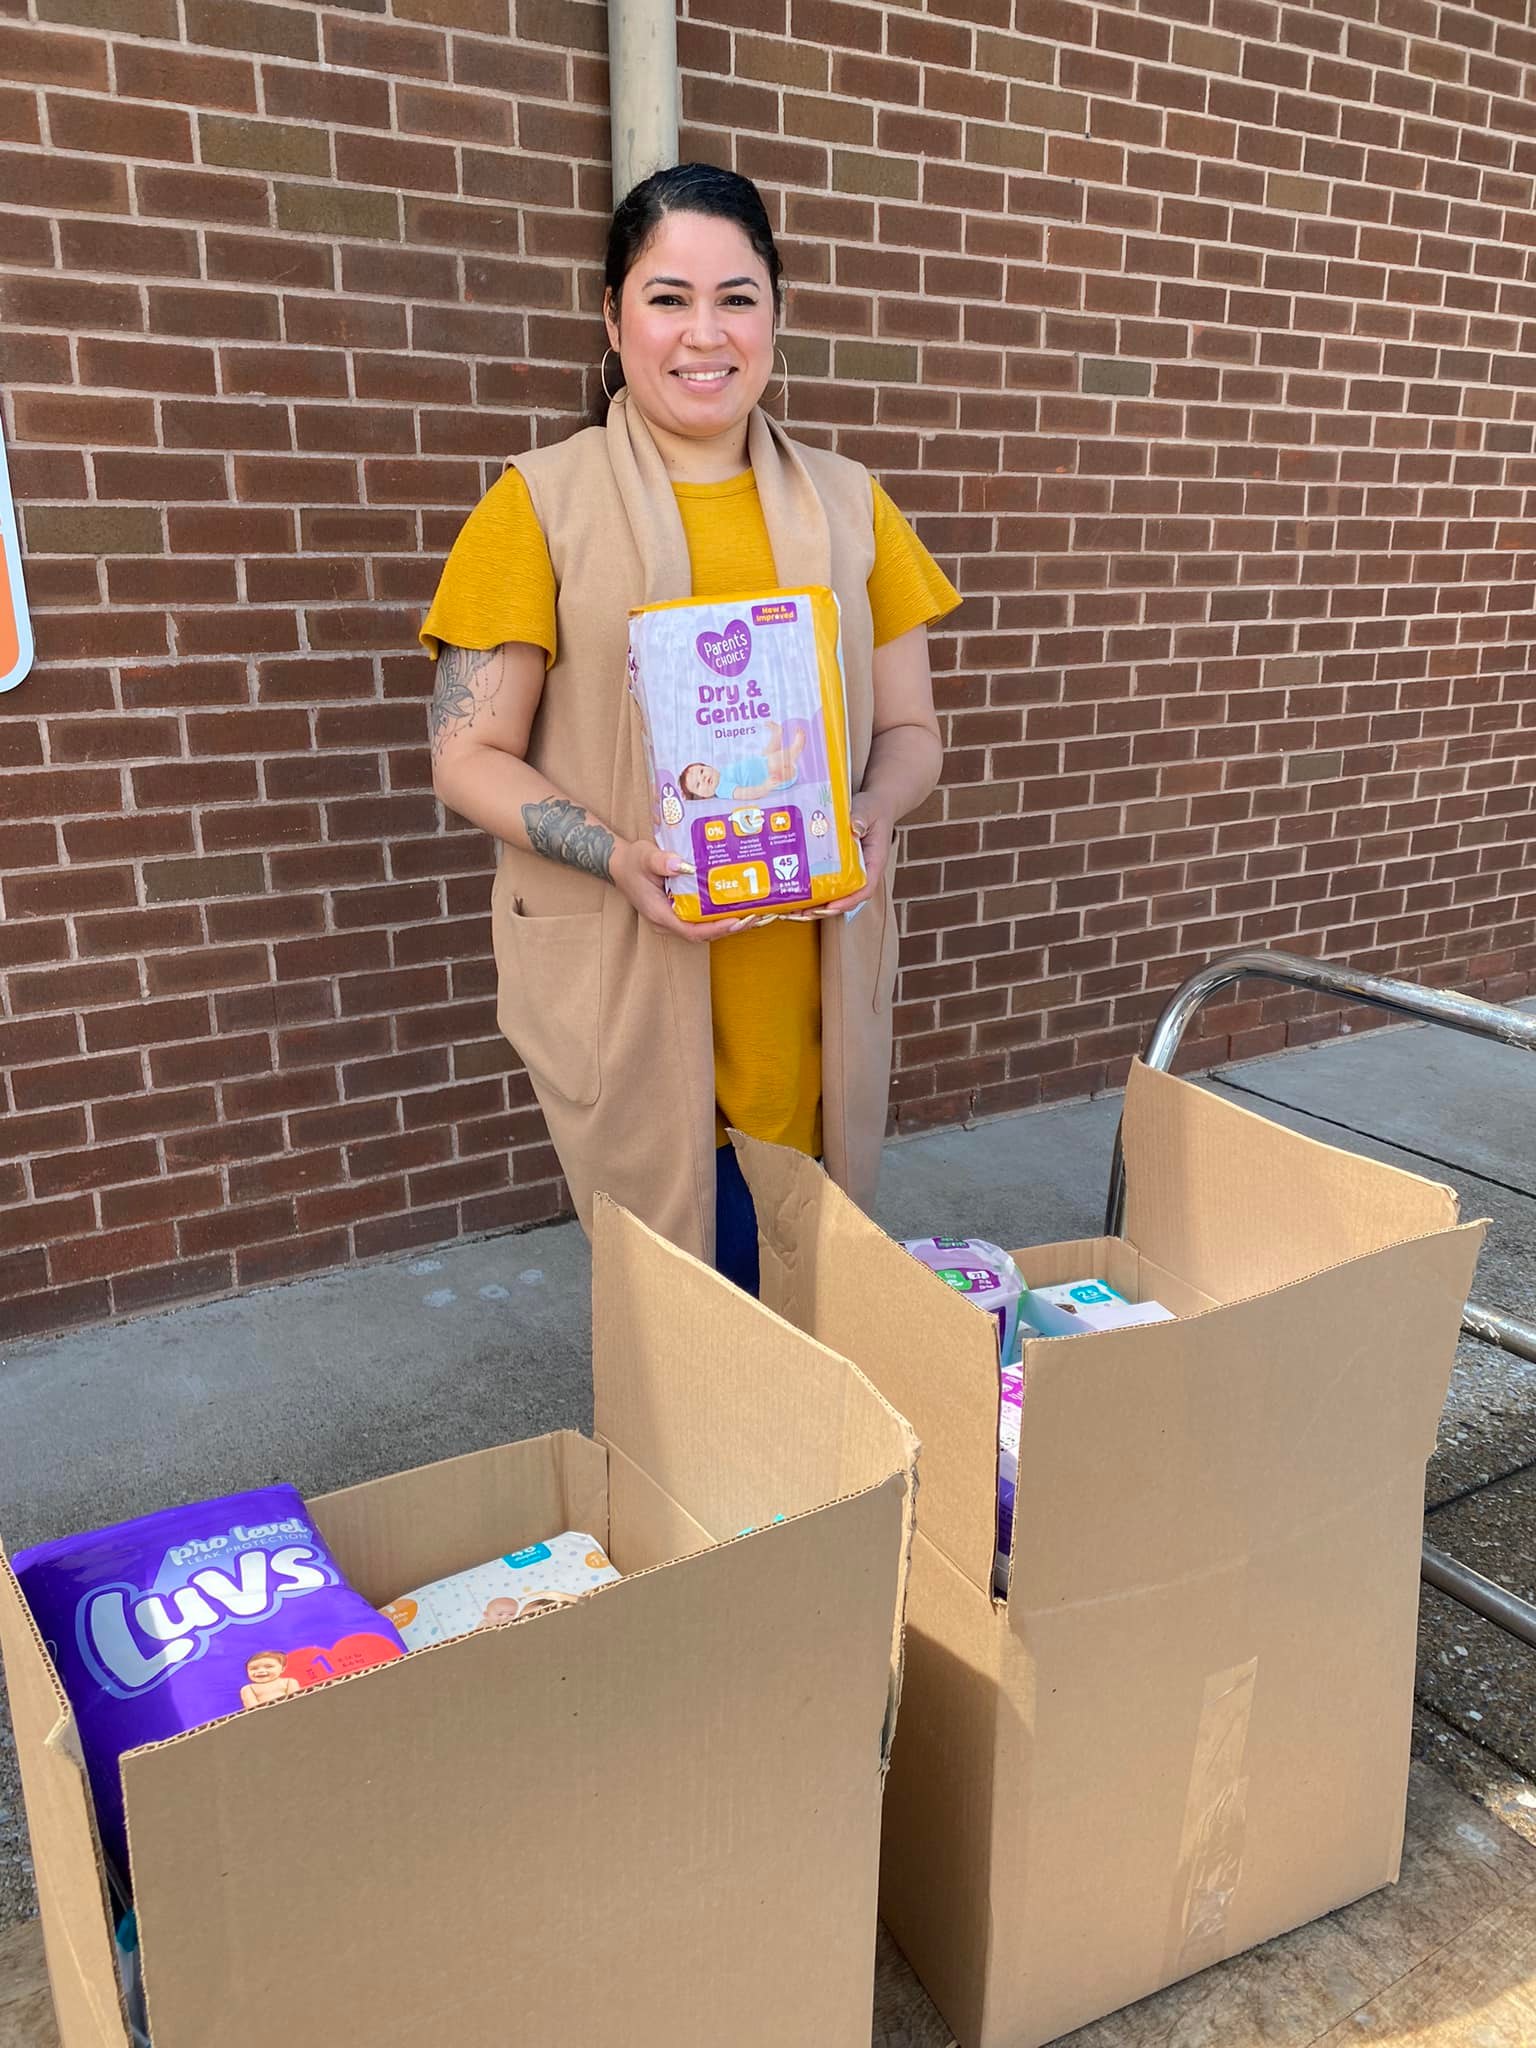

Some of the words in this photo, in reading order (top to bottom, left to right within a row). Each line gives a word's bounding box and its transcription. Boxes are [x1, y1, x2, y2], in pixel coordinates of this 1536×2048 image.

[761, 606, 780, 614] New
[715, 649, 746, 668] CHOICE
[698, 684, 740, 705] Dry
[746, 679, 762, 697] &
[695, 699, 771, 726] Gentle
[714, 726, 756, 739] Diapers
[707, 826, 724, 837] 0%
[779, 857, 793, 866] 45
[714, 879, 739, 891] Size
[742, 867, 759, 895] 1
[169, 1537, 229, 1566] pro
[233, 1518, 308, 1541] level
[186, 1551, 221, 1566] LEAK
[225, 1533, 309, 1554] PROTECTION
[90, 1547, 326, 1688] Luvs
[311, 1654, 335, 1675] 1
